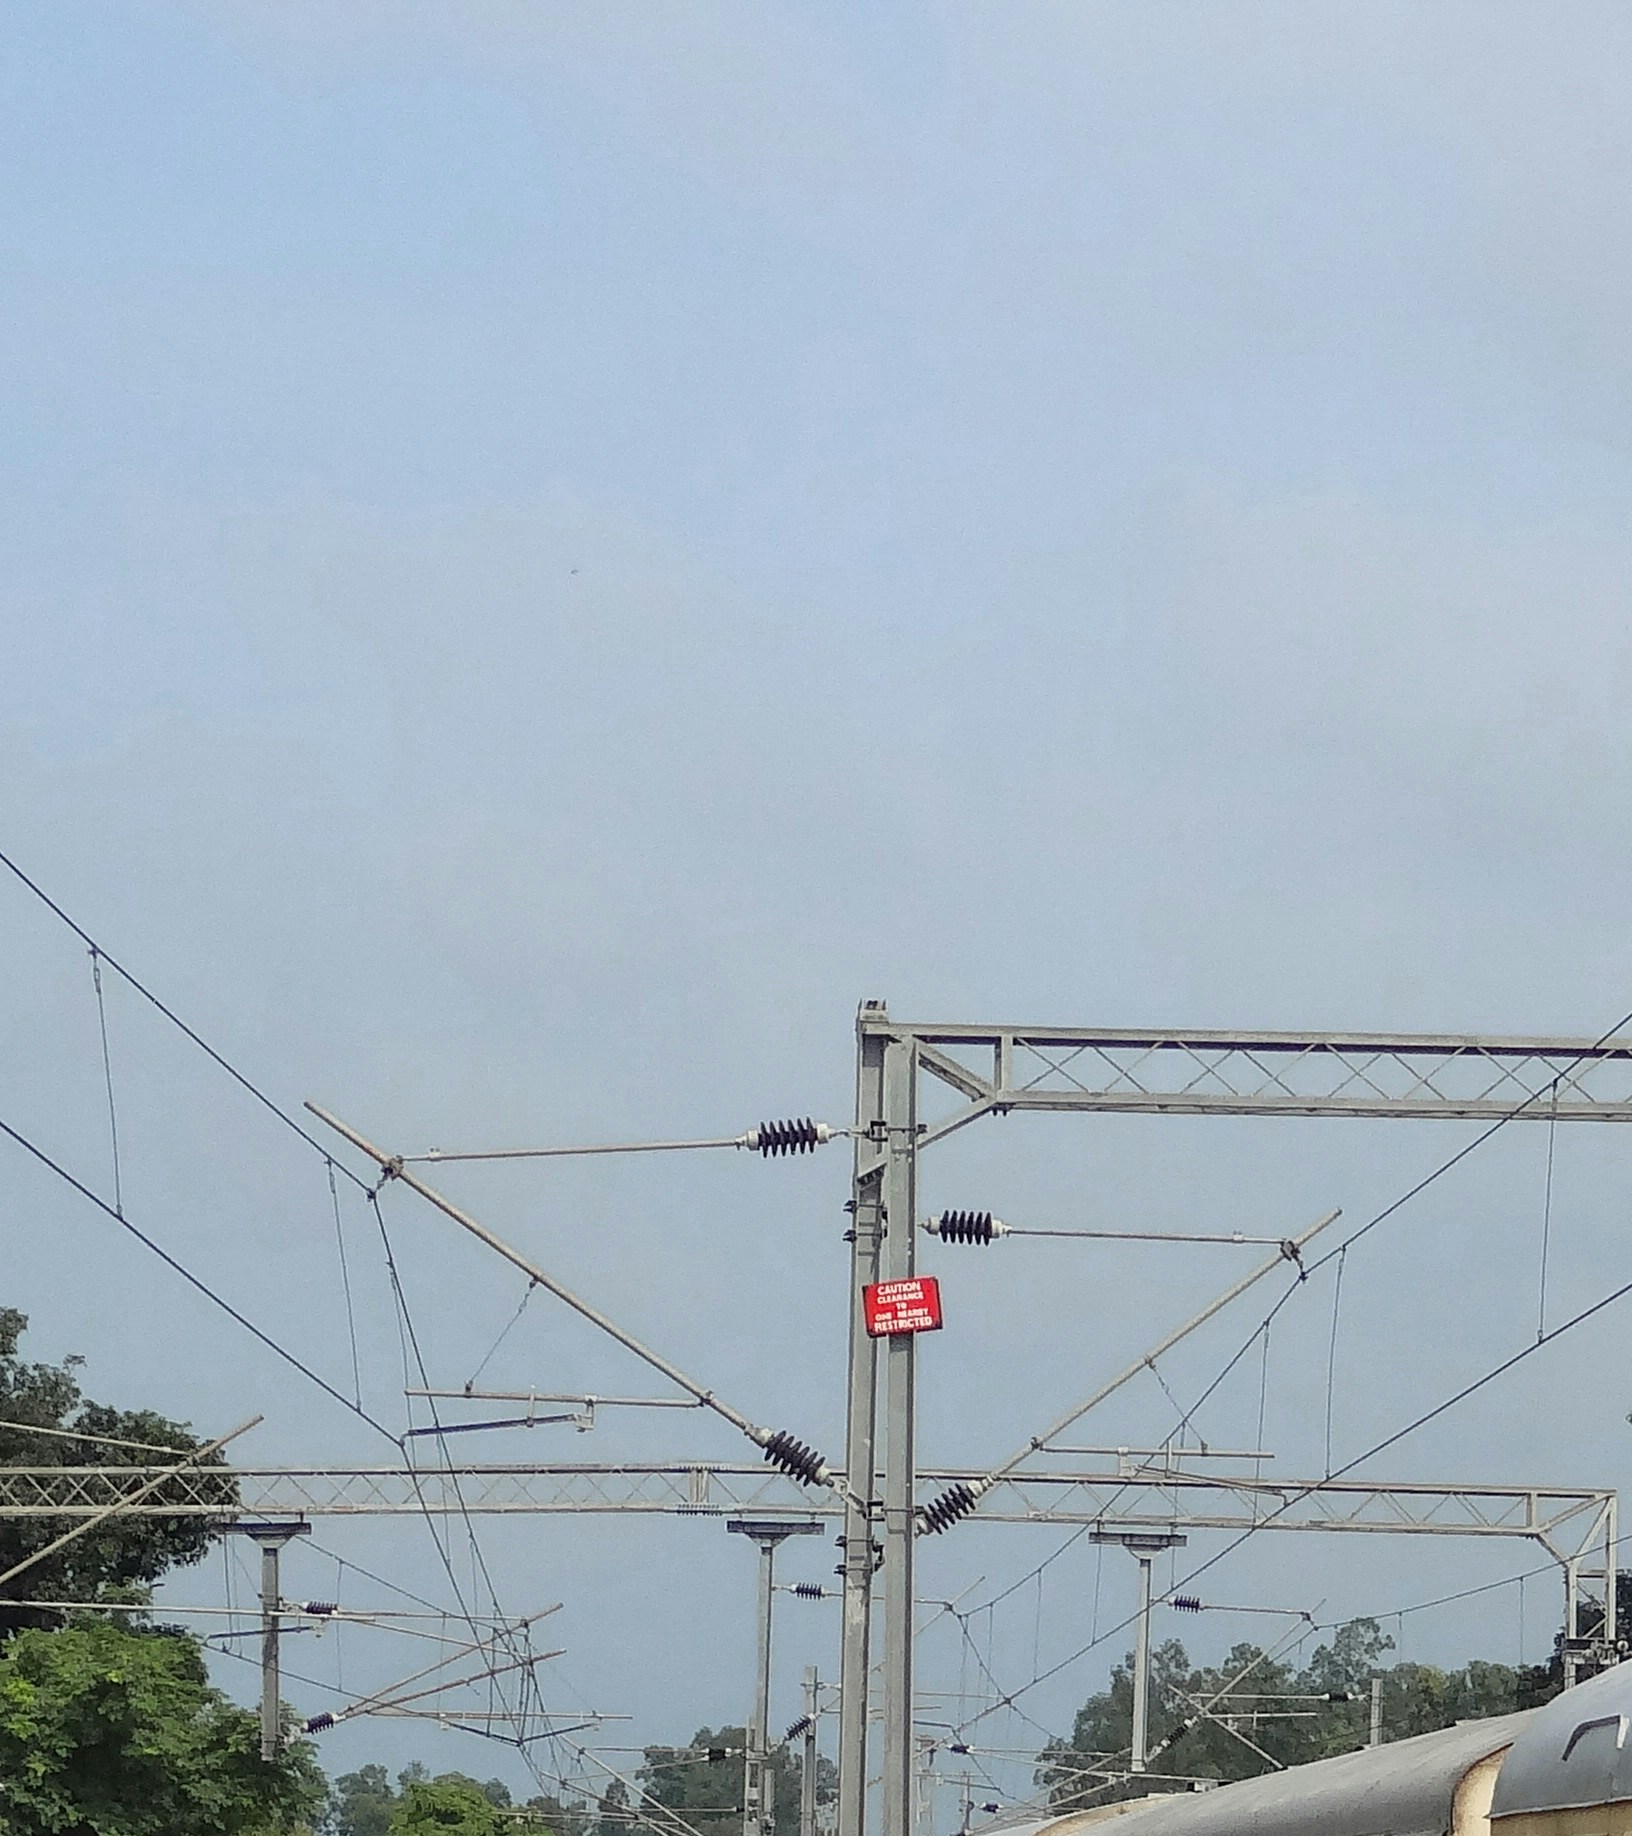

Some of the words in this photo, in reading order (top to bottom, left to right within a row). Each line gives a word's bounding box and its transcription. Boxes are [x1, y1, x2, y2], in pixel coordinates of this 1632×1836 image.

[877, 1281, 921, 1296] CAUTION
[877, 1291, 924, 1305] CLEARANCE
[895, 1302, 908, 1310] TO
[874, 1316, 933, 1333] RESTRICTED
